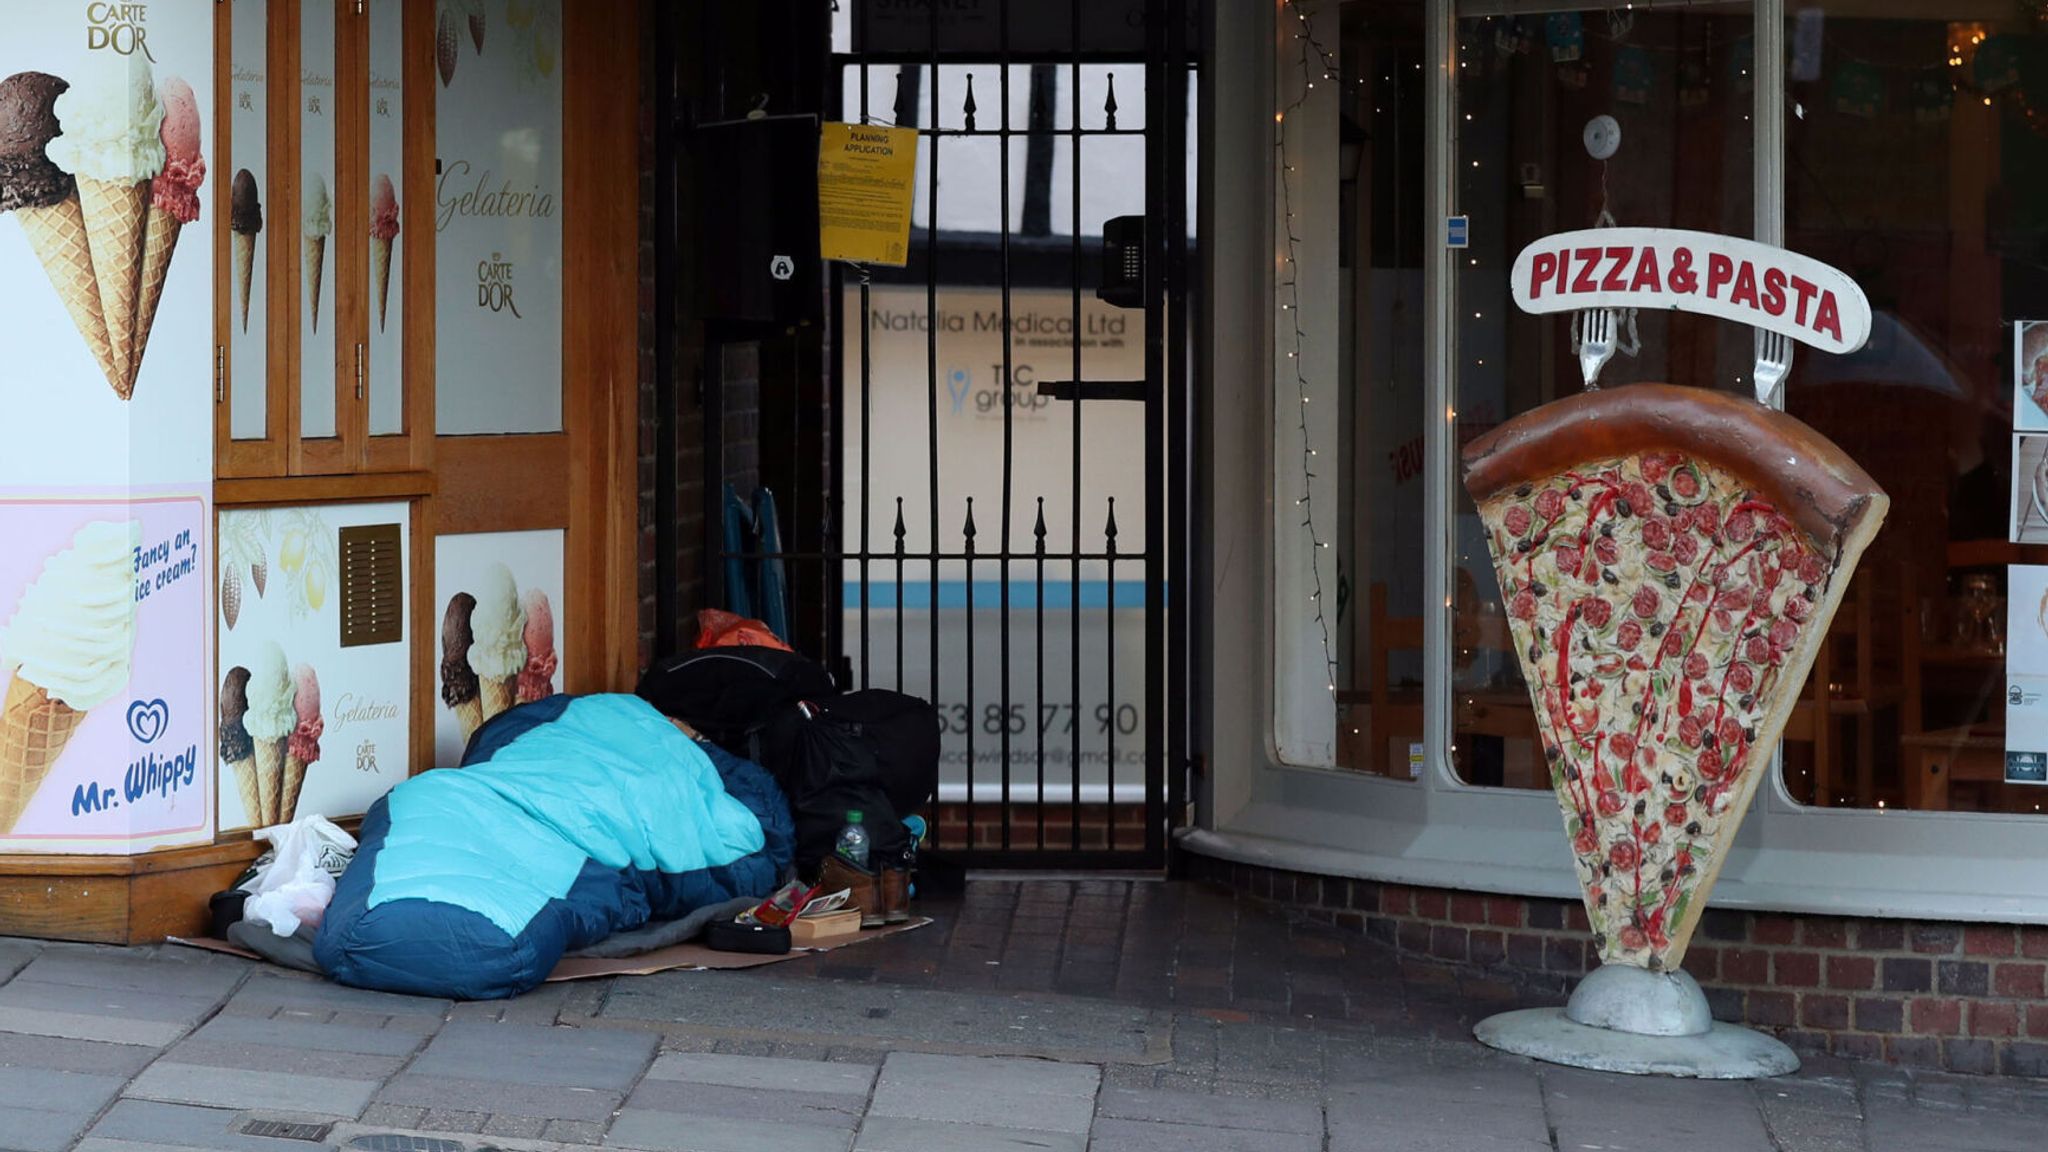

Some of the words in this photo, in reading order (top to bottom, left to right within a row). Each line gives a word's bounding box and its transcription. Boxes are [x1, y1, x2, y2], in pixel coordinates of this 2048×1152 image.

[87, 2, 148, 24] CARTE
[87, 22, 157, 64] D'OR
[844, 143, 894, 156] APPLICATION
[850, 132, 889, 144] PLANNING
[435, 160, 556, 232] Gelateria
[477, 260, 514, 282] CARTE
[1087, 313, 1126, 335] Ltd
[991, 364, 1034, 386] TC
[133, 538, 170, 573] Fancy
[174, 528, 190, 550] an
[135, 578, 151, 602] ice
[156, 543, 197, 590] cream?
[333, 691, 400, 733] Gelateria
[983, 703, 1026, 735] 85
[1094, 703, 1138, 735] 90
[72, 781, 119, 816] Mr.
[124, 744, 196, 804] Whippy
